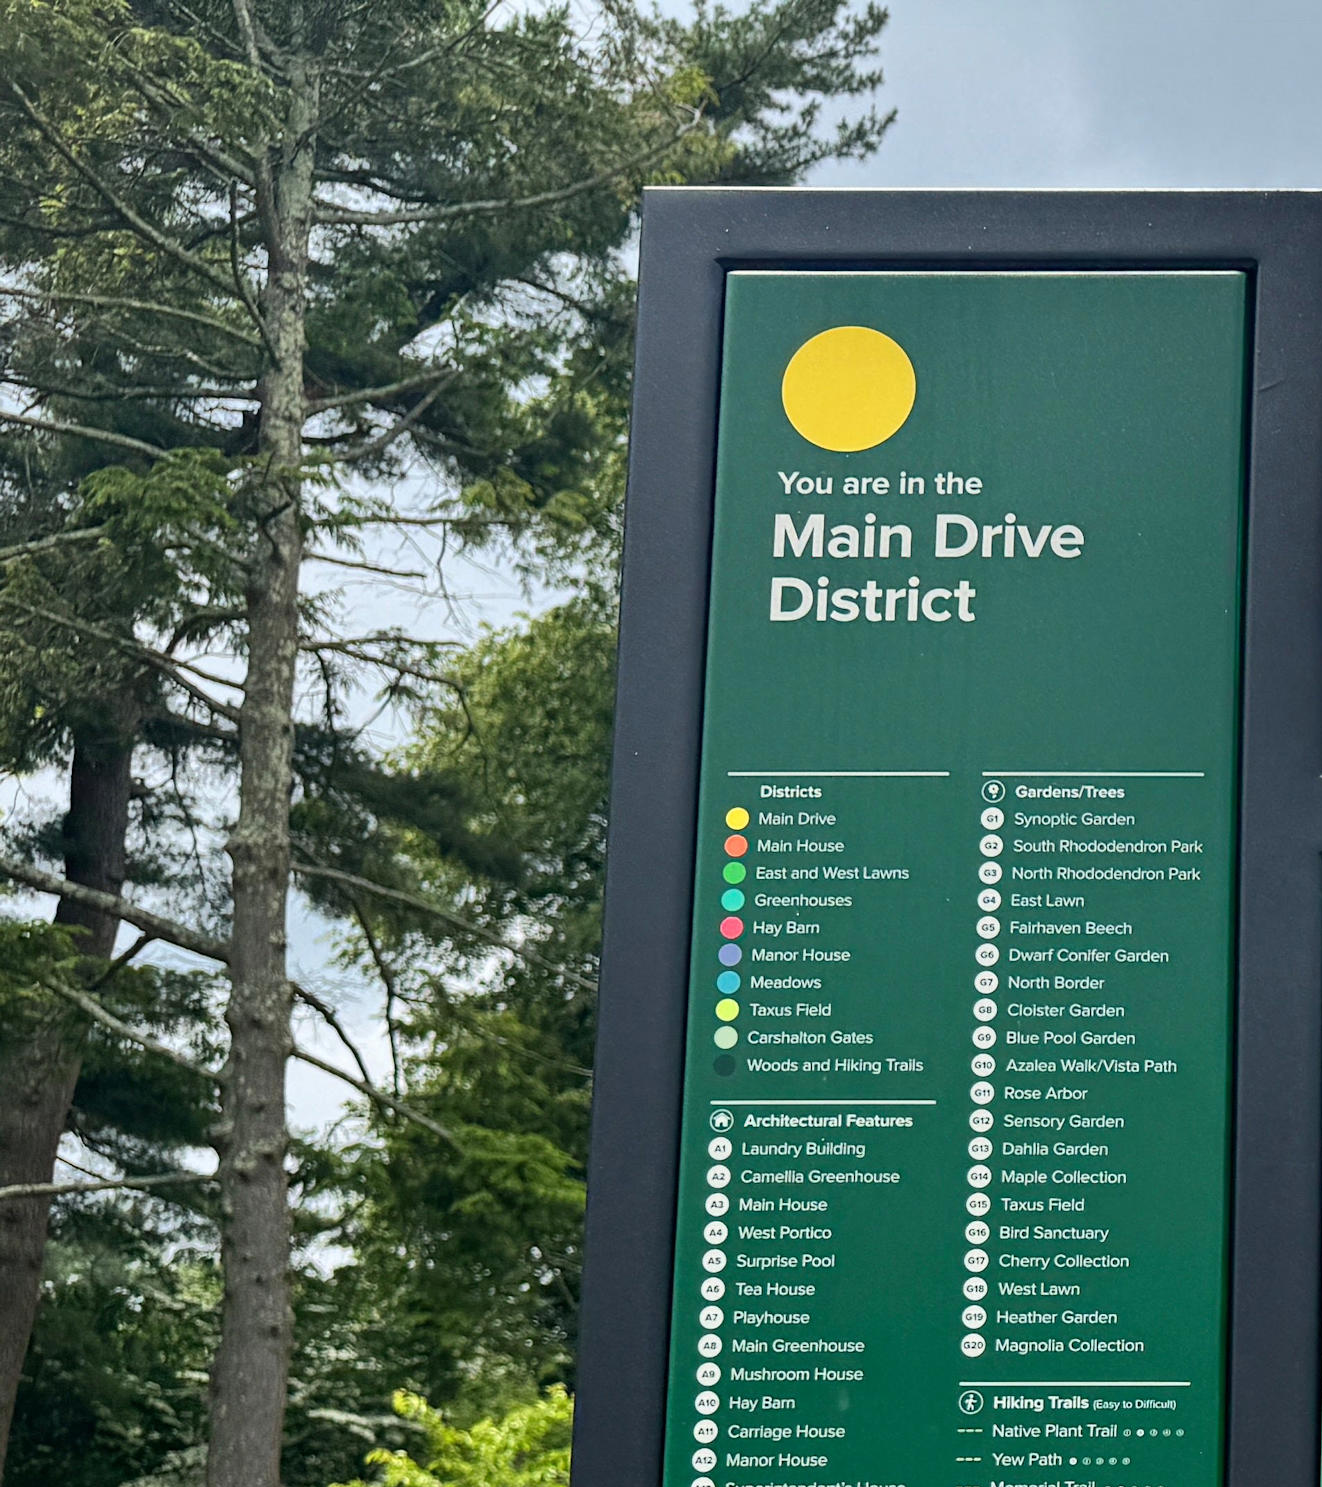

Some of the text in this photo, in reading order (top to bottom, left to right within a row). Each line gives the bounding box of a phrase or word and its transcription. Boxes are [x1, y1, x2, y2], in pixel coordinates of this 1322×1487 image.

[777, 470, 983, 495] You are in the
[772, 512, 1085, 559] Main Drive
[769, 575, 976, 622] District
[760, 784, 823, 798] Districts
[1014, 784, 1126, 799] Gardens/Trees
[758, 811, 837, 826] Main Drive
[1014, 812, 1078, 829] Synoptic
[1080, 812, 1135, 826] Garden
[1013, 839, 1204, 854] South Rhododendron Park
[755, 866, 910, 880] East and West Lawns
[754, 893, 853, 907] Greenhouses
[753, 920, 820, 938] Hay Barn
[1010, 920, 1133, 935] Fairhaven Beech
[751, 948, 851, 962] Manor House
[750, 975, 822, 990] Meadows
[1008, 975, 1105, 990] North Border
[746, 1057, 924, 1075] Woods and Hiking Trails
[1005, 1058, 1057, 1073] Azalea
[1059, 1058, 1140, 1073] Walk/Vista
[1144, 1059, 1177, 1073] Path
[743, 1113, 914, 1128] Architectural Features
[1003, 1113, 1066, 1131] Sensory
[1068, 1114, 1125, 1129] Garden
[740, 1169, 901, 1184] Camellia Greenhouse
[1001, 1169, 1048, 1186] Maple
[1051, 1169, 1127, 1184] Collection
[737, 1225, 833, 1240] West Portico
[999, 1225, 1030, 1240] Bird
[1033, 1225, 1110, 1243] Sanctuary
[736, 1253, 798, 1271] Surprise
[801, 1253, 836, 1268] Pool
[998, 1253, 1051, 1271] Cherry
[1053, 1253, 1130, 1268] Collection
[998, 1282, 1081, 1296] West Lawn
[733, 1310, 811, 1328] Playhouse
[730, 1367, 864, 1381] Mushroom House
[993, 1395, 1177, 1413] Hiking Trails (Easy to Difficult)
[991, 1452, 1063, 1467] Yew Path
